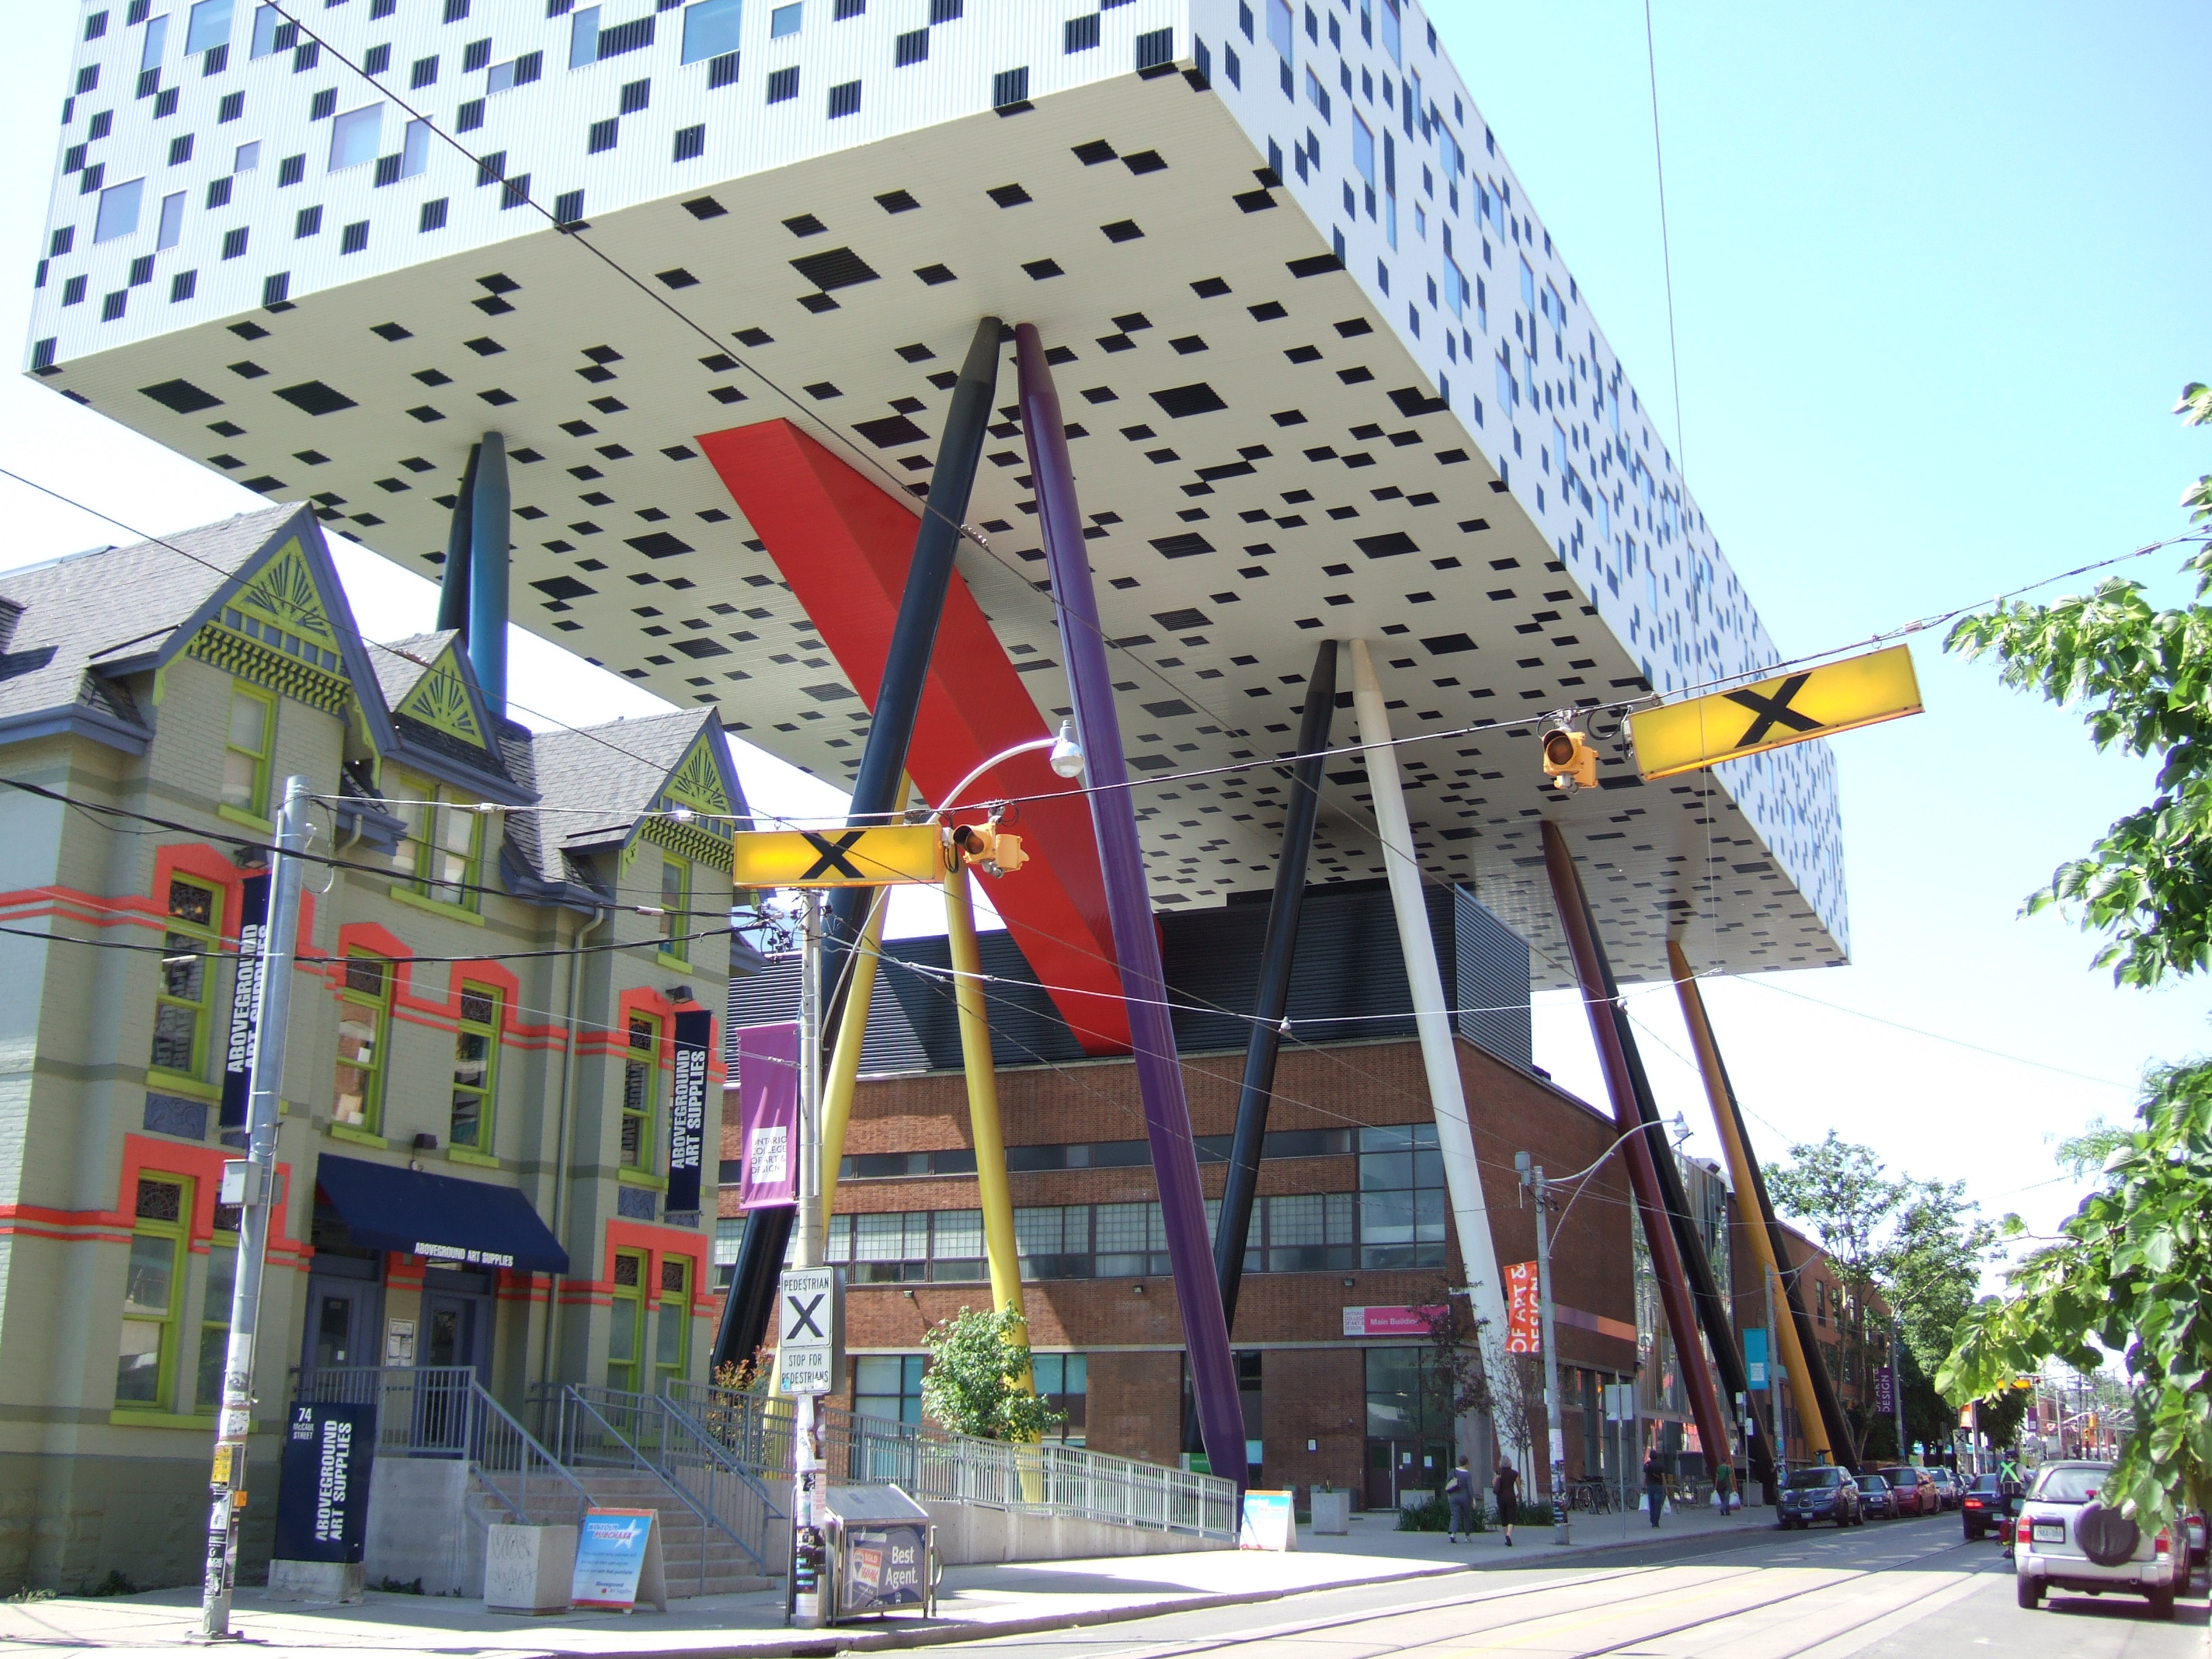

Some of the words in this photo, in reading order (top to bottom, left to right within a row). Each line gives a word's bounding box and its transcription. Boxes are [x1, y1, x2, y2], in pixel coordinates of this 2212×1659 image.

[228, 923, 258, 1073] ABOVEGROUND
[687, 1051, 706, 1129] SUPPLIES
[671, 1049, 690, 1169] ABOVEGROUND
[685, 1135, 701, 1167] ART
[754, 1136, 787, 1146] NTRIO
[414, 1241, 466, 1260] ABOVEGROUND
[467, 1249, 482, 1263] ART
[482, 1251, 513, 1267] SUPPLIES
[784, 1276, 829, 1292] PEDESTRIAN
[1511, 1263, 1526, 1280] &
[1513, 1284, 1527, 1323] ART
[1511, 1327, 1527, 1352] OF
[788, 1354, 805, 1367] STOP
[809, 1353, 823, 1366] FOR
[781, 1371, 829, 1384] PEDESTRIANS
[1881, 1374, 1890, 1412] DESIGN
[298, 1407, 312, 1422] 74
[333, 1422, 352, 1502] SUPPLIES
[315, 1420, 338, 1542] ABOVEGROUND
[329, 1508, 344, 1540] ART
[864, 1553, 878, 1563] SOLD
[892, 1546, 914, 1564] Best
[885, 1567, 918, 1589] Agent.
